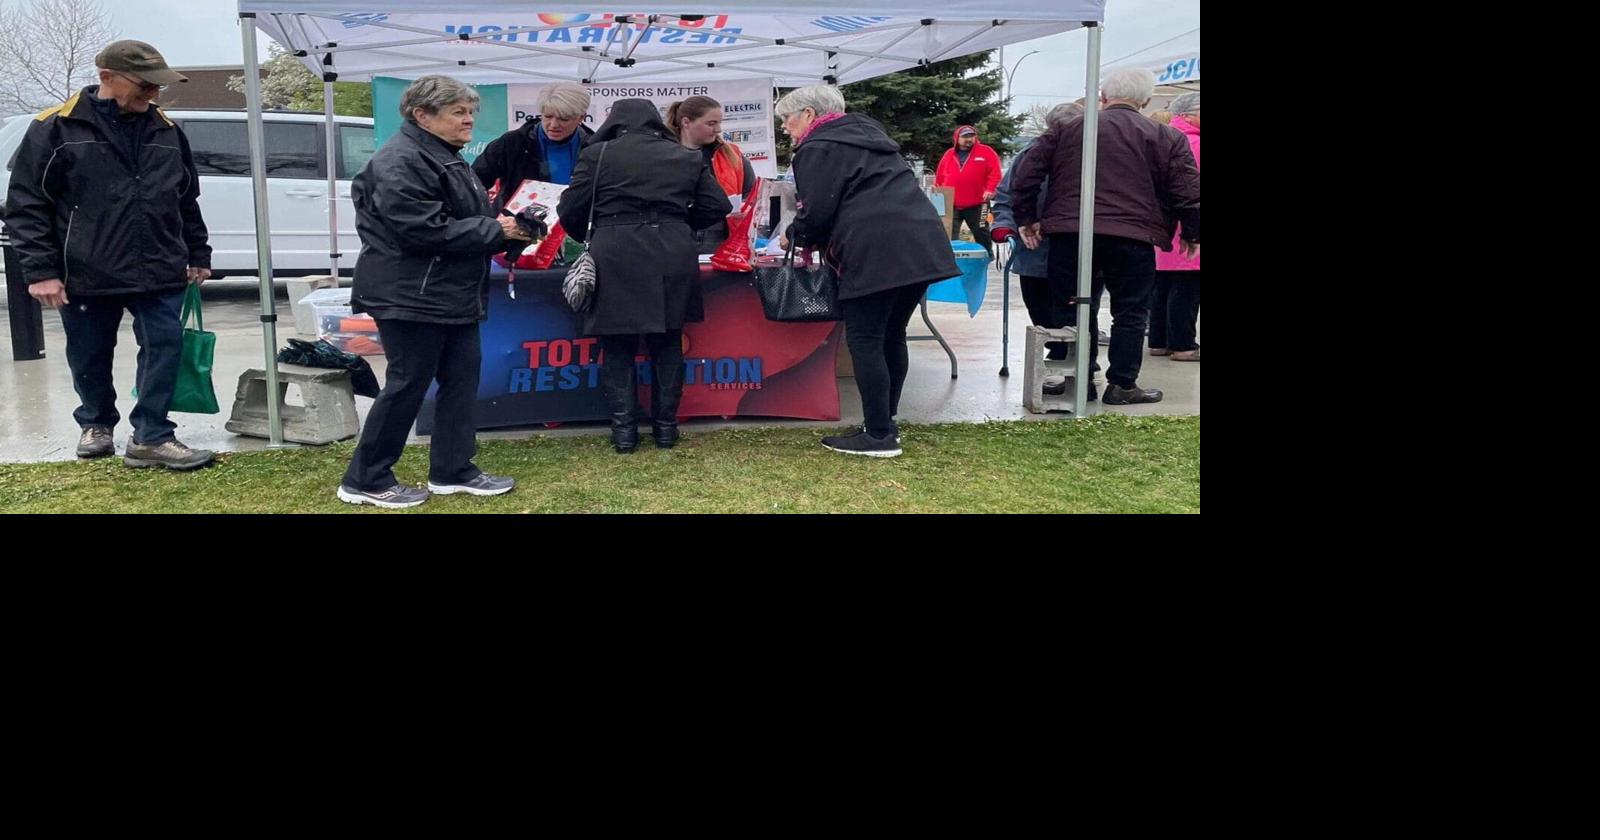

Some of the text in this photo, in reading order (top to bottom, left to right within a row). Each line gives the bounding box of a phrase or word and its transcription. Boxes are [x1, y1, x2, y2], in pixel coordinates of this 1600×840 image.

[587, 86, 709, 97] SPONSORS MATTER
[724, 103, 761, 113] ELECTRIC
[508, 357, 764, 393] RESTRTION
